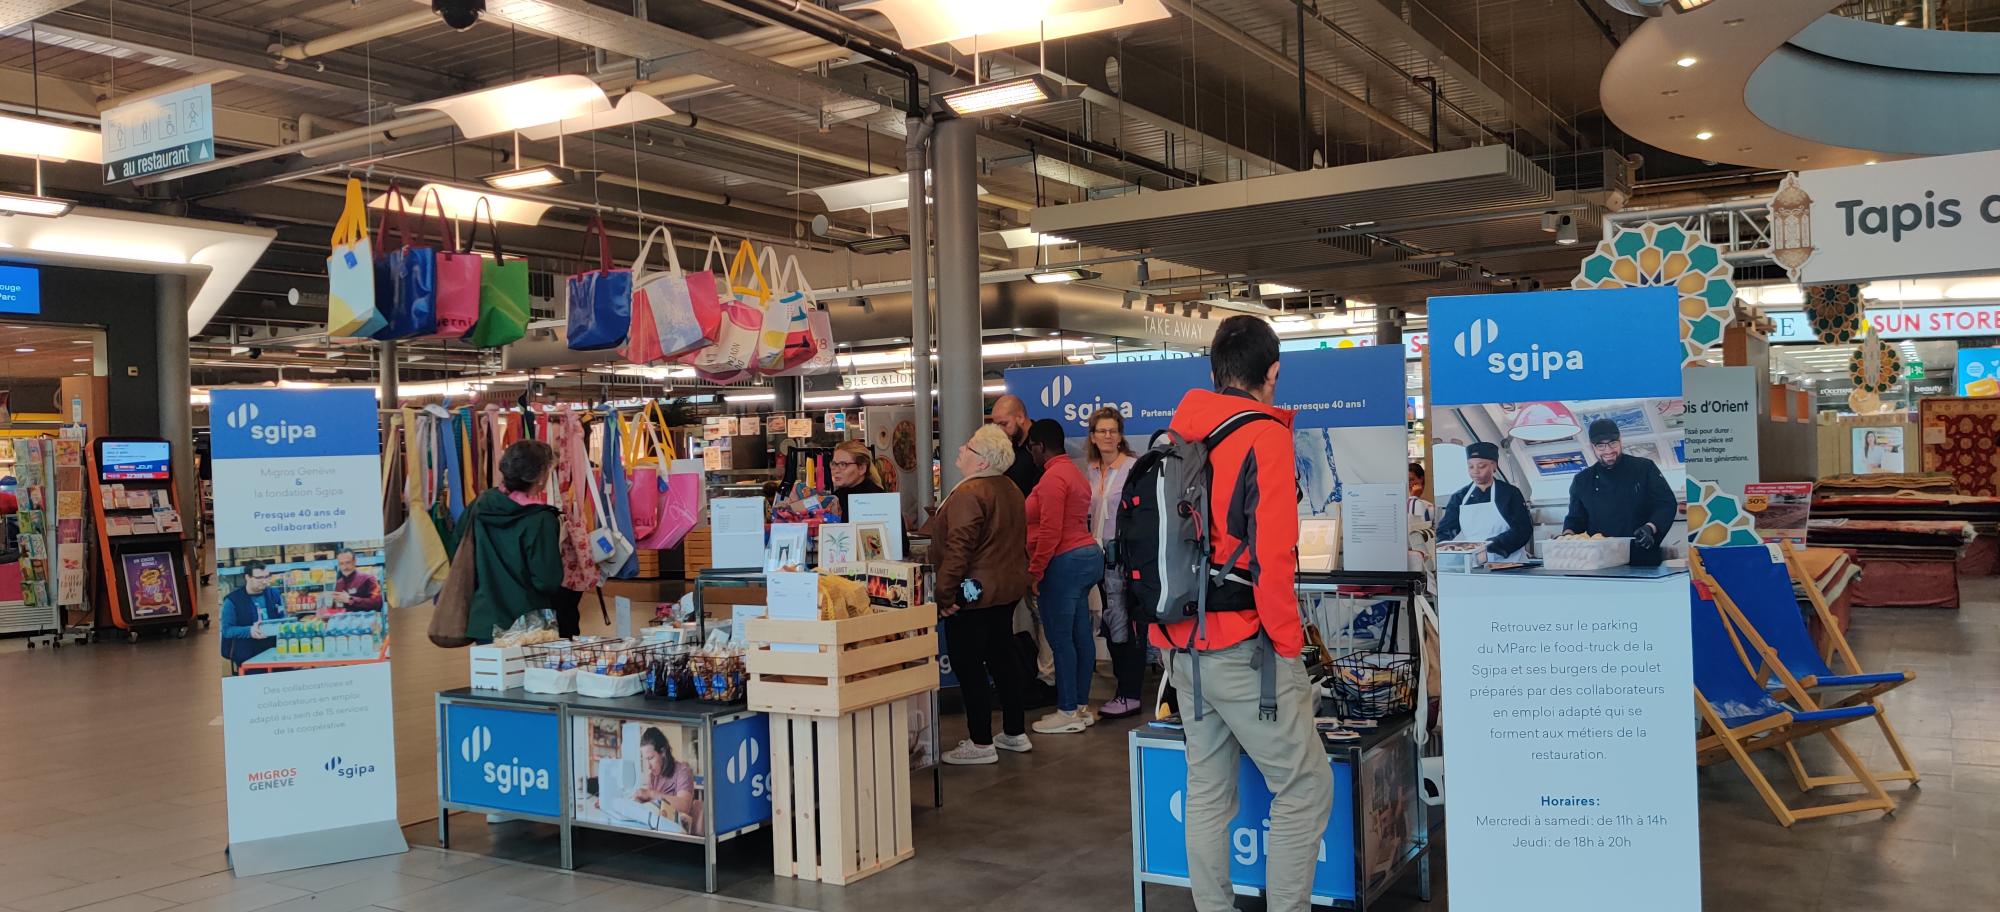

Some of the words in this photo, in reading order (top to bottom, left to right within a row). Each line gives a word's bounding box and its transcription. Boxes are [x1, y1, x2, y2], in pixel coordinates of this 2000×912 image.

[123, 162, 136, 177] au
[138, 146, 190, 174] restaurant
[1835, 190, 1962, 242] Tapis
[1144, 316, 1170, 336] TAKE
[1173, 321, 1203, 339] AWAY
[1873, 313, 1920, 333] SUN
[1488, 343, 1584, 381] sgipa
[854, 377, 867, 387] LE
[1914, 384, 1943, 393] beauty
[1294, 403, 1330, 411] presque
[1332, 400, 1343, 408] 40
[1701, 400, 1748, 413] d'Orient
[251, 420, 316, 445] sgipa
[260, 467, 296, 480] Migros
[254, 489, 263, 499] la
[264, 486, 313, 499] fondation
[315, 486, 343, 498] Sgipa
[254, 510, 296, 522] Presque
[299, 509, 311, 518] 40
[314, 510, 331, 518] ans
[334, 507, 345, 516] de
[1491, 621, 1552, 633] Retrouvez
[1555, 623, 1574, 632] sur
[1578, 620, 1588, 631] le
[1592, 620, 1638, 634] parking
[1478, 643, 1494, 654] du
[1497, 643, 1537, 653] MParc
[1540, 642, 1550, 653] le
[1554, 642, 1620, 653] food-truck
[1624, 642, 1640, 652] de
[1644, 641, 1653, 652] la
[1472, 665, 1507, 678] Sgipa
[1511, 664, 1523, 675] et
[1526, 666, 1546, 674] ses
[1551, 664, 1598, 677] burgers
[1601, 663, 1617, 674] de
[1621, 663, 1661, 676] poulet
[264, 686, 280, 695] Des
[282, 681, 343, 693] collaboratrices
[1470, 686, 1523, 699] préparés
[1527, 688, 1546, 699] par
[1549, 685, 1572, 696] des
[1576, 685, 1664, 695] collaborateurs
[258, 696, 317, 709] collaborateurs
[332, 692, 360, 703] emploi
[249, 713, 279, 725] adapté
[336, 705, 368, 714] services
[1493, 709, 1508, 718] en
[1512, 706, 1555, 720] emploi
[1558, 706, 1602, 719] adapté
[1606, 706, 1624, 719] qui
[1628, 707, 1642, 716] se
[274, 728, 286, 736] de
[1490, 728, 1540, 739] forment
[1542, 730, 1563, 738] aux
[1567, 727, 1613, 738] métiers
[1617, 727, 1633, 738] de
[1636, 727, 1647, 738] la
[1531, 749, 1606, 760] restauration.
[248, 768, 297, 782] MIGROS
[338, 764, 375, 779] sgipa
[483, 758, 548, 796] sgipa
[1476, 816, 1531, 826] Mercredi
[1535, 816, 1541, 826] à
[1597, 815, 1613, 826] de
[1616, 815, 1633, 826] 11h
[1637, 815, 1643, 825] à
[1647, 815, 1667, 825] 14h
[1555, 837, 1571, 848] de
[1574, 837, 1594, 848] 18h
[1598, 837, 1605, 847] à
[1608, 837, 1631, 847] 20h
